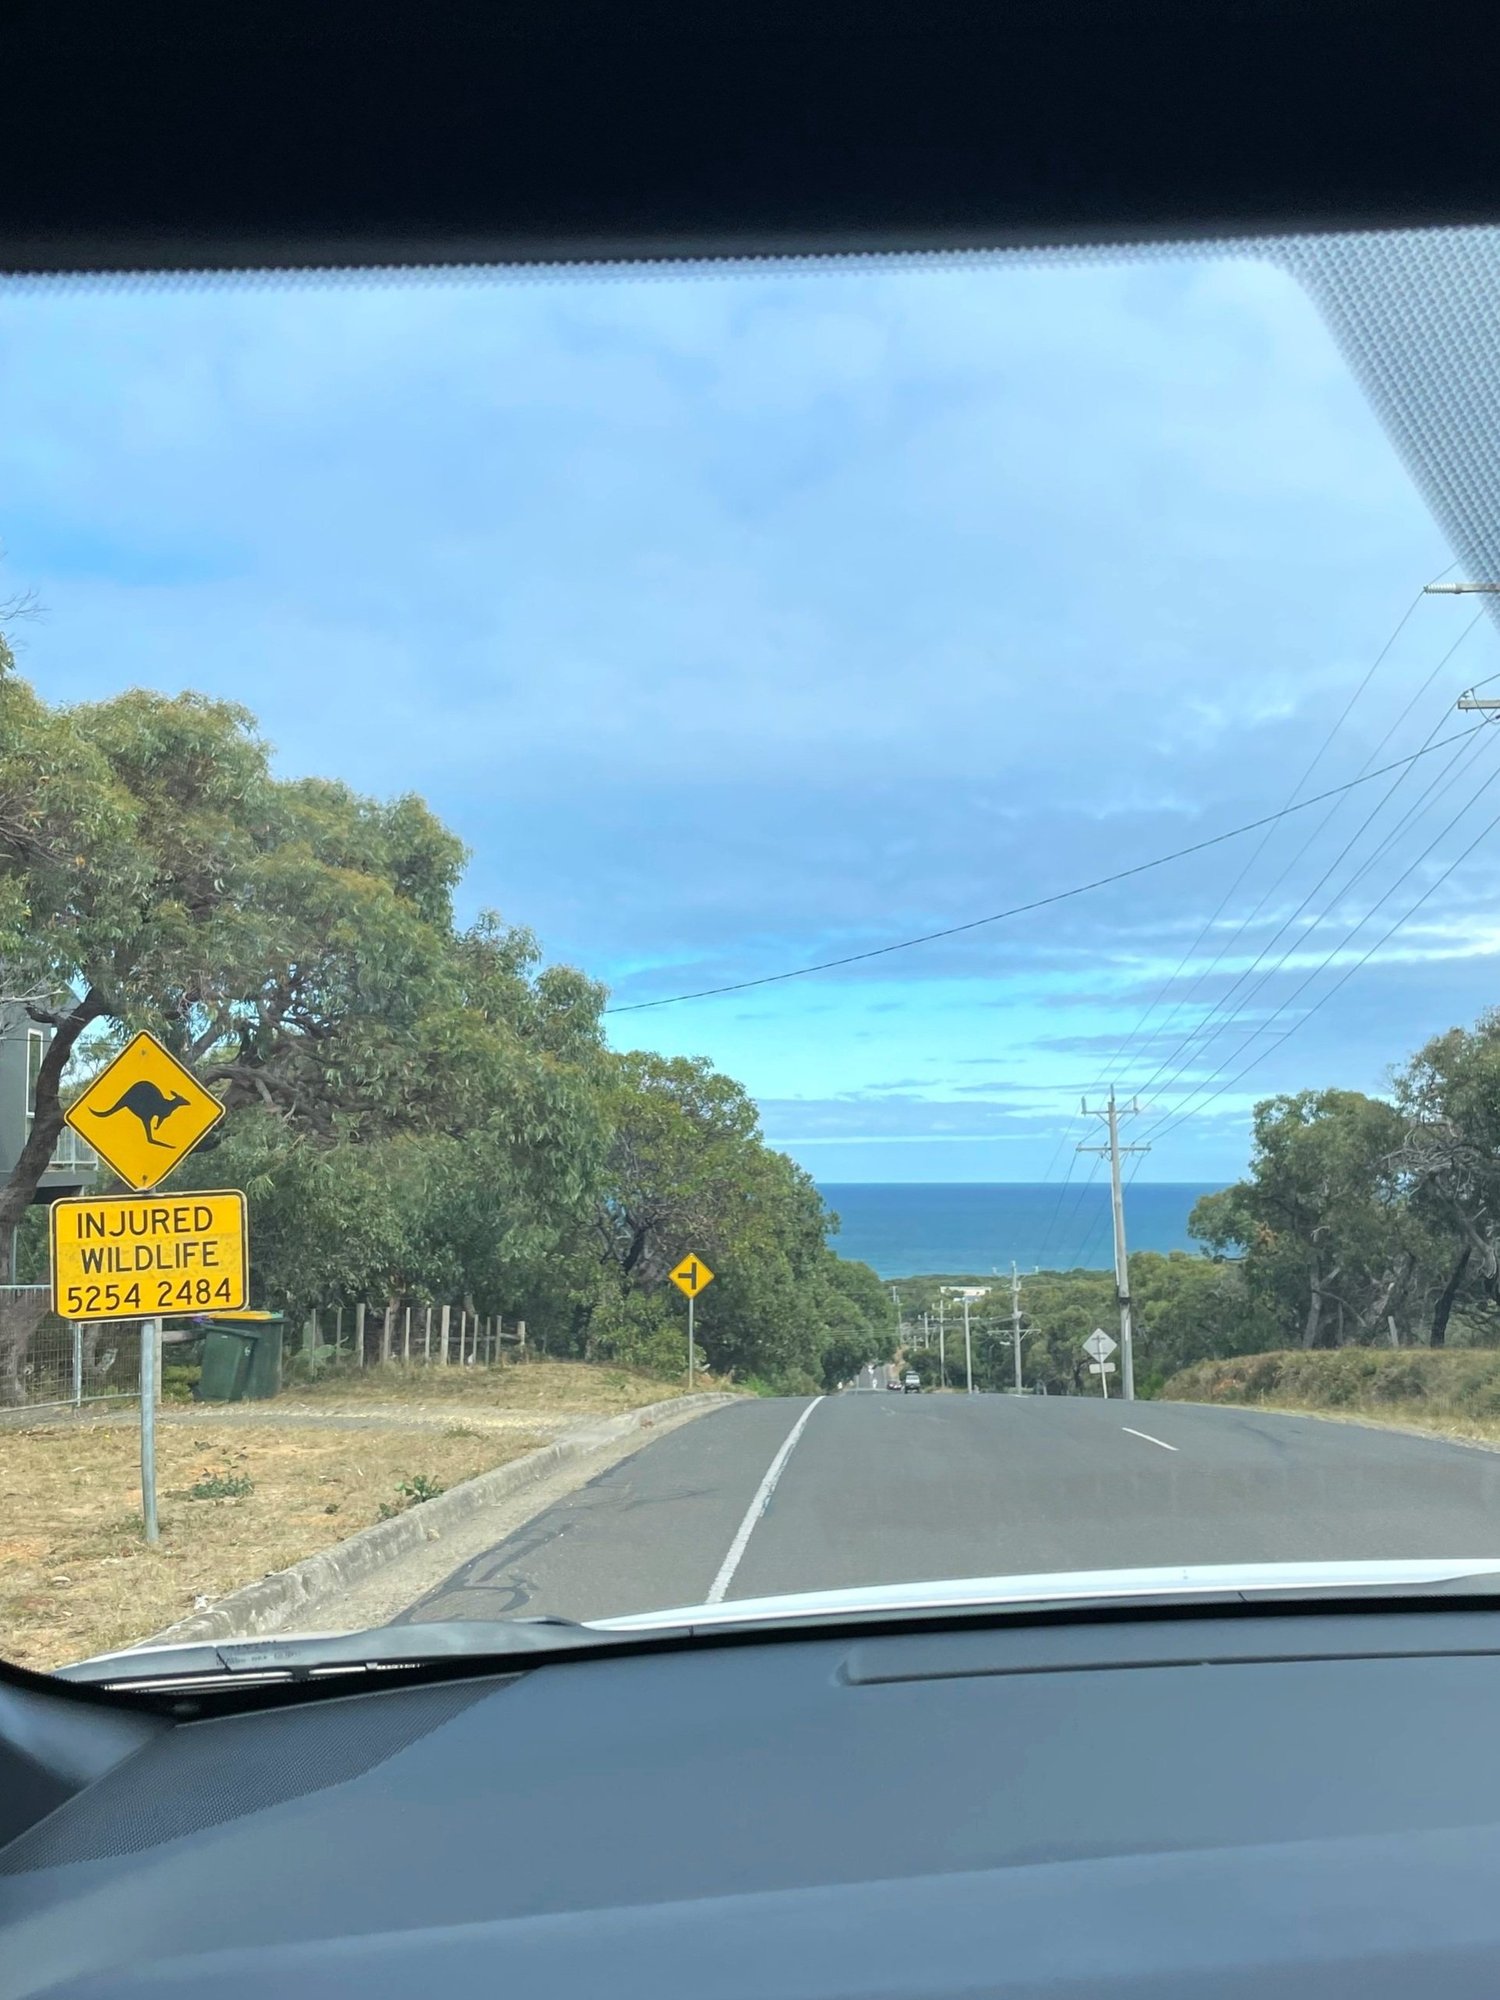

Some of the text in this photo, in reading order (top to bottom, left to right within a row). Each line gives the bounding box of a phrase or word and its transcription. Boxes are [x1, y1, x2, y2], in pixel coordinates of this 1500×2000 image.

[77, 1206, 213, 1239] INJURED
[81, 1241, 219, 1274] WILDLIFE
[68, 1278, 231, 1313] 5254 2484
